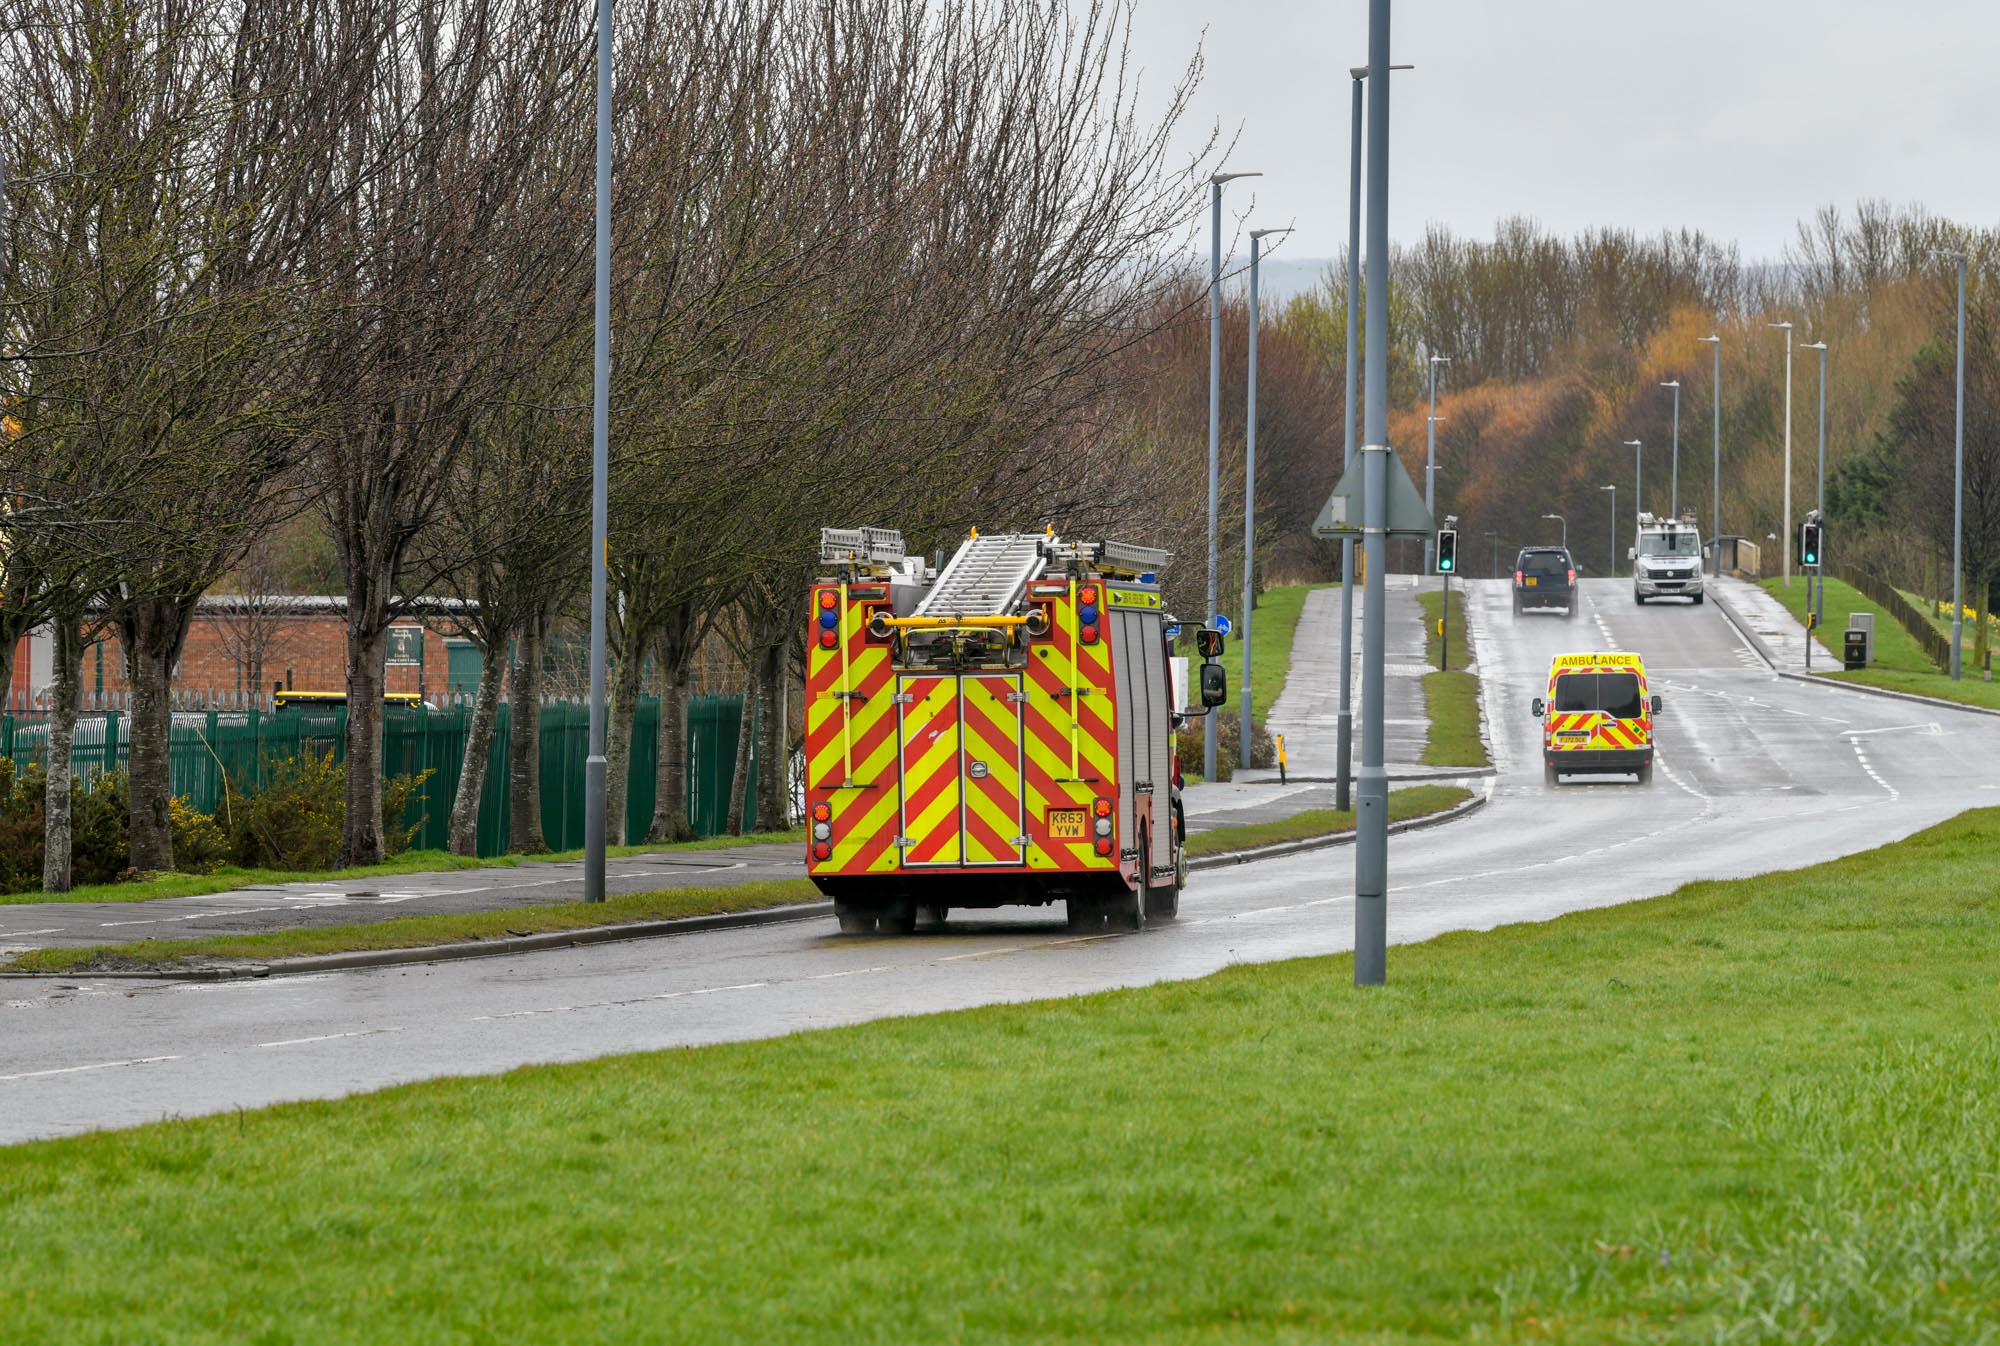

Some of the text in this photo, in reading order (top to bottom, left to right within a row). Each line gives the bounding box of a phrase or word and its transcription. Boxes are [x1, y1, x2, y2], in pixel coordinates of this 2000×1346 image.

[1561, 656, 1631, 665] AMBULANCE
[1052, 812, 1083, 824] KR63
[1057, 825, 1079, 836] YVW
